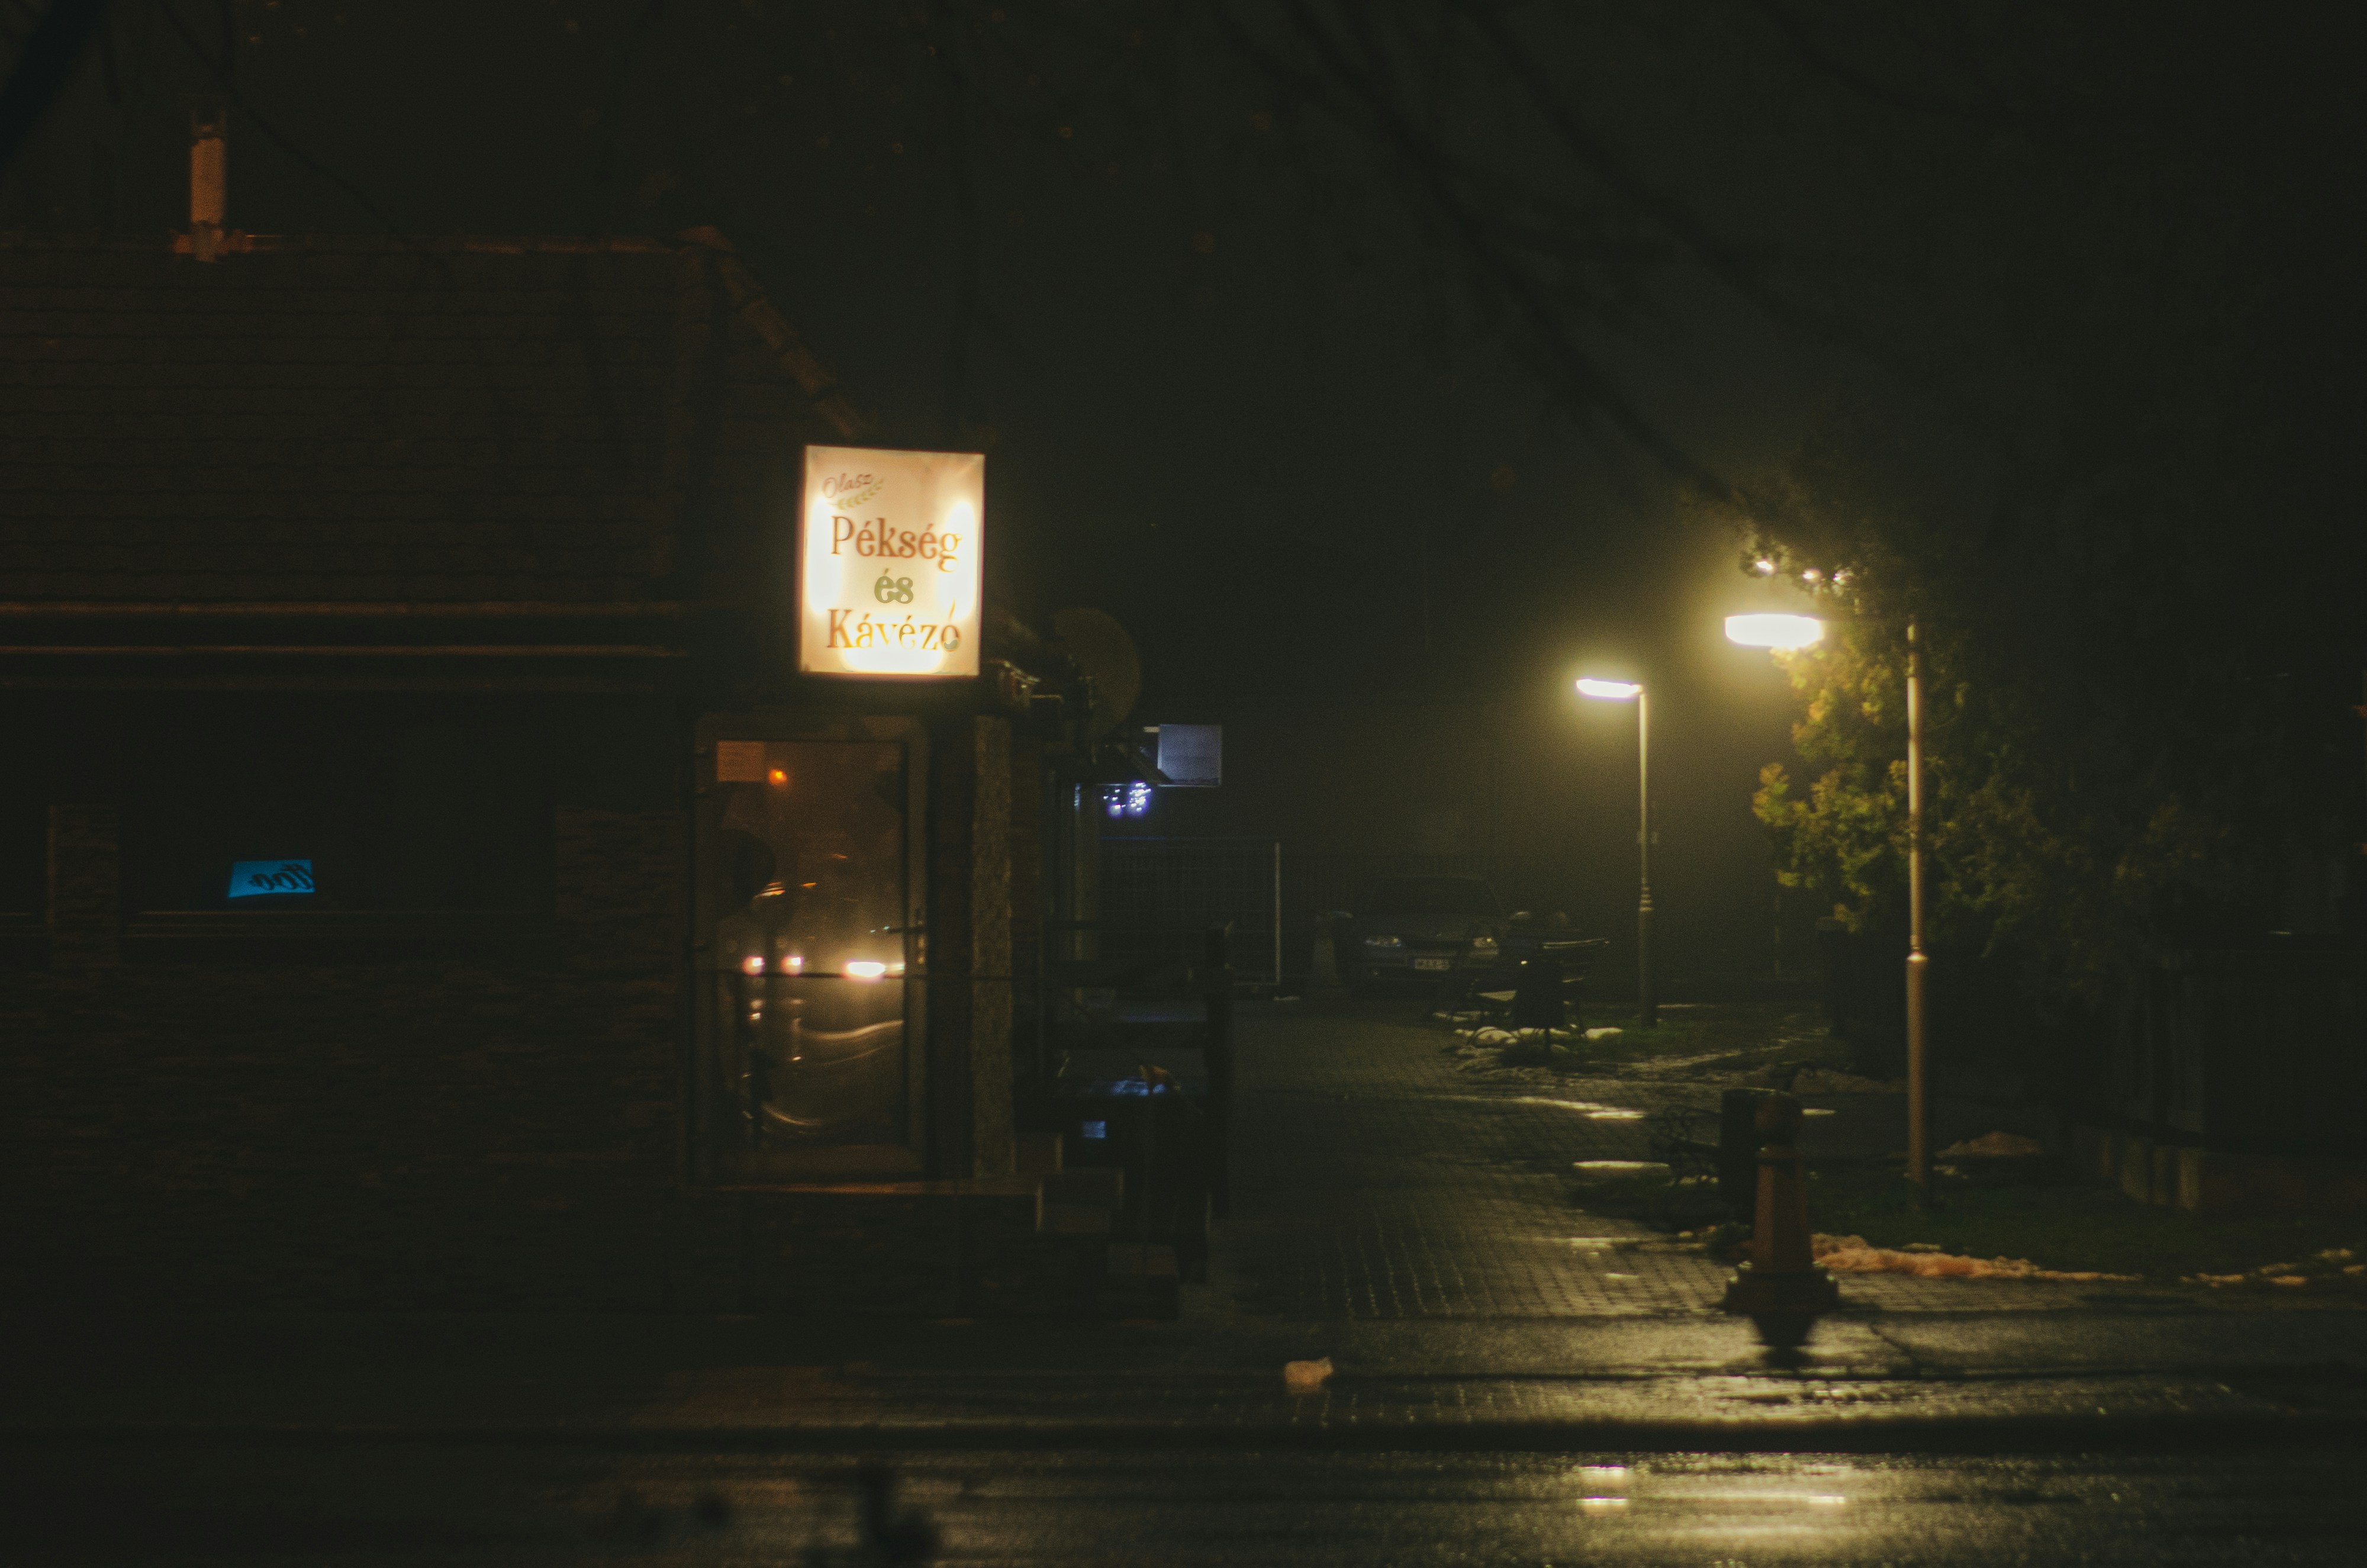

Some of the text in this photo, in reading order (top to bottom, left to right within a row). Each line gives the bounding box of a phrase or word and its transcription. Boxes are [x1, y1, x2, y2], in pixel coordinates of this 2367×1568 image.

[823, 473, 873, 498] Olasz
[830, 516, 962, 572] Pékség
[874, 568, 914, 604] és
[827, 597, 961, 652] Kávézó
